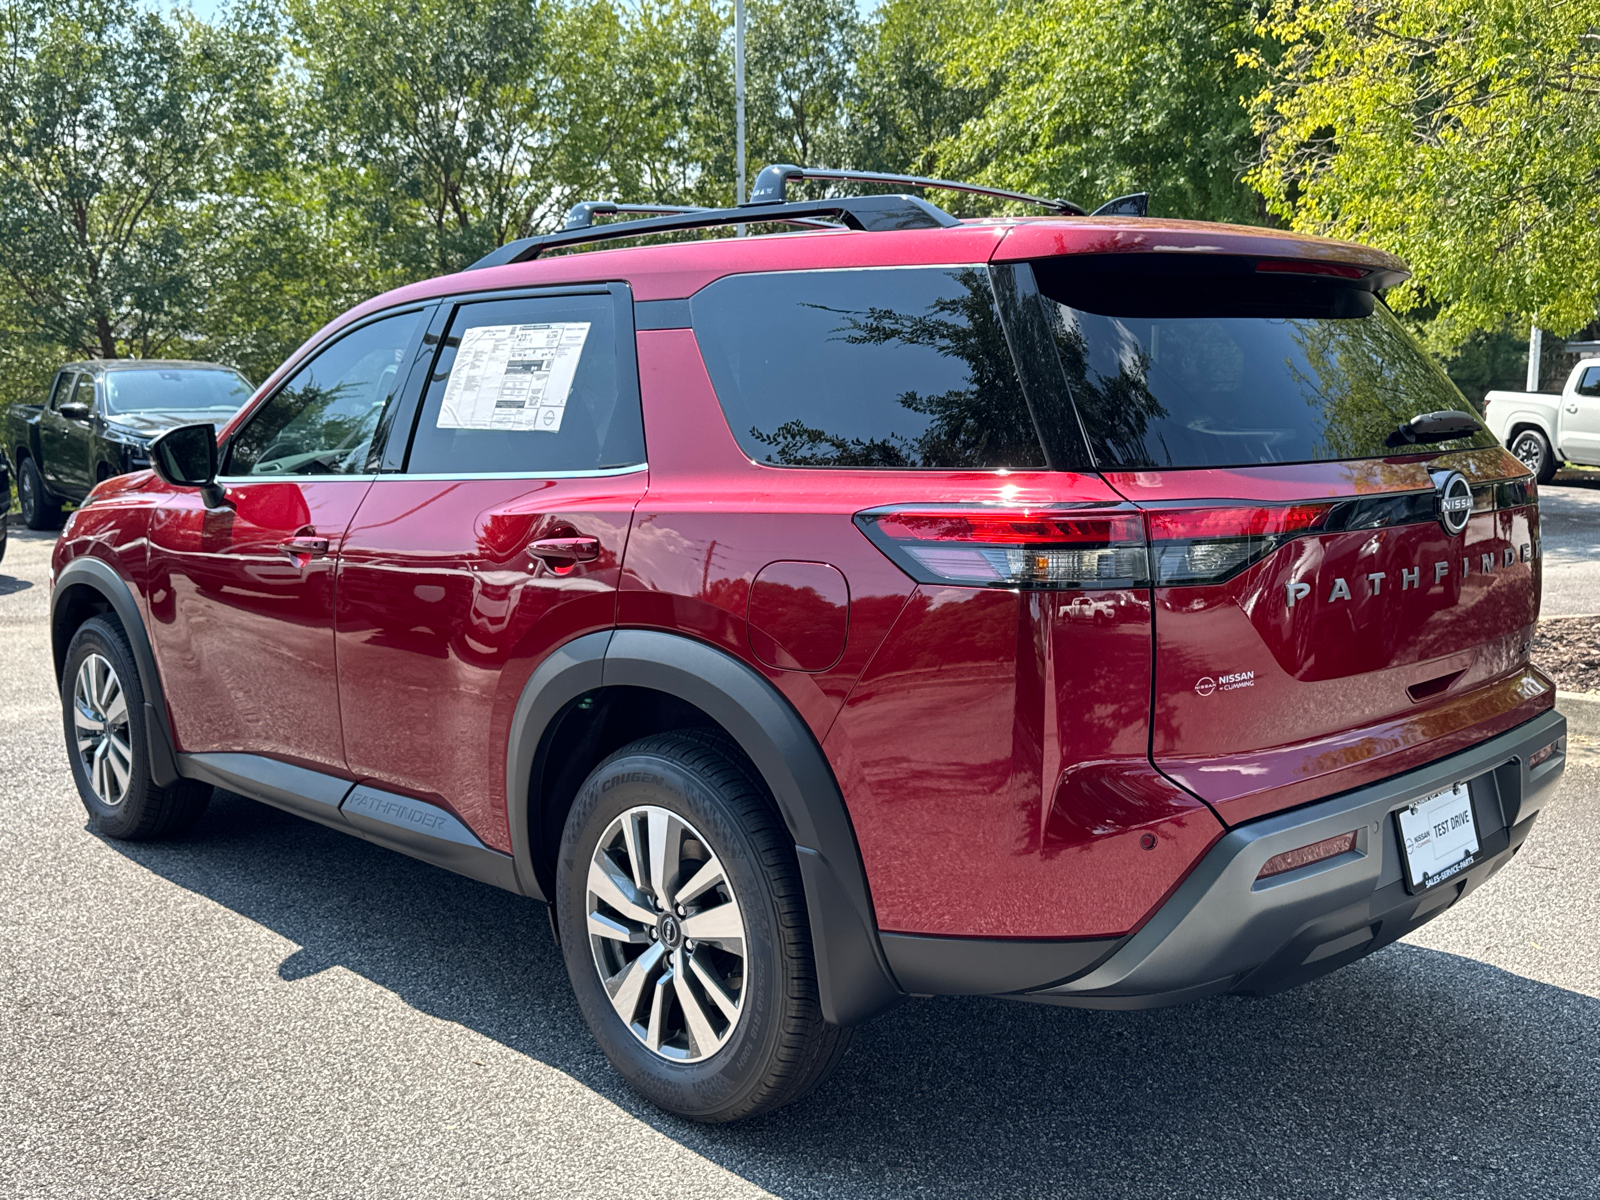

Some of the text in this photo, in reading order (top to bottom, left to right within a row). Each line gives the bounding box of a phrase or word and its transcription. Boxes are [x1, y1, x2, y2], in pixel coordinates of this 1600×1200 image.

[1443, 497, 1474, 510] NISSAN
[1219, 670, 1255, 685] NISSAN
[602, 771, 665, 793] CRUGEN
[349, 792, 447, 830] PATHFINDER
[1433, 810, 1470, 838] TEST DRIVE
[1413, 830, 1431, 844] NISSAN
